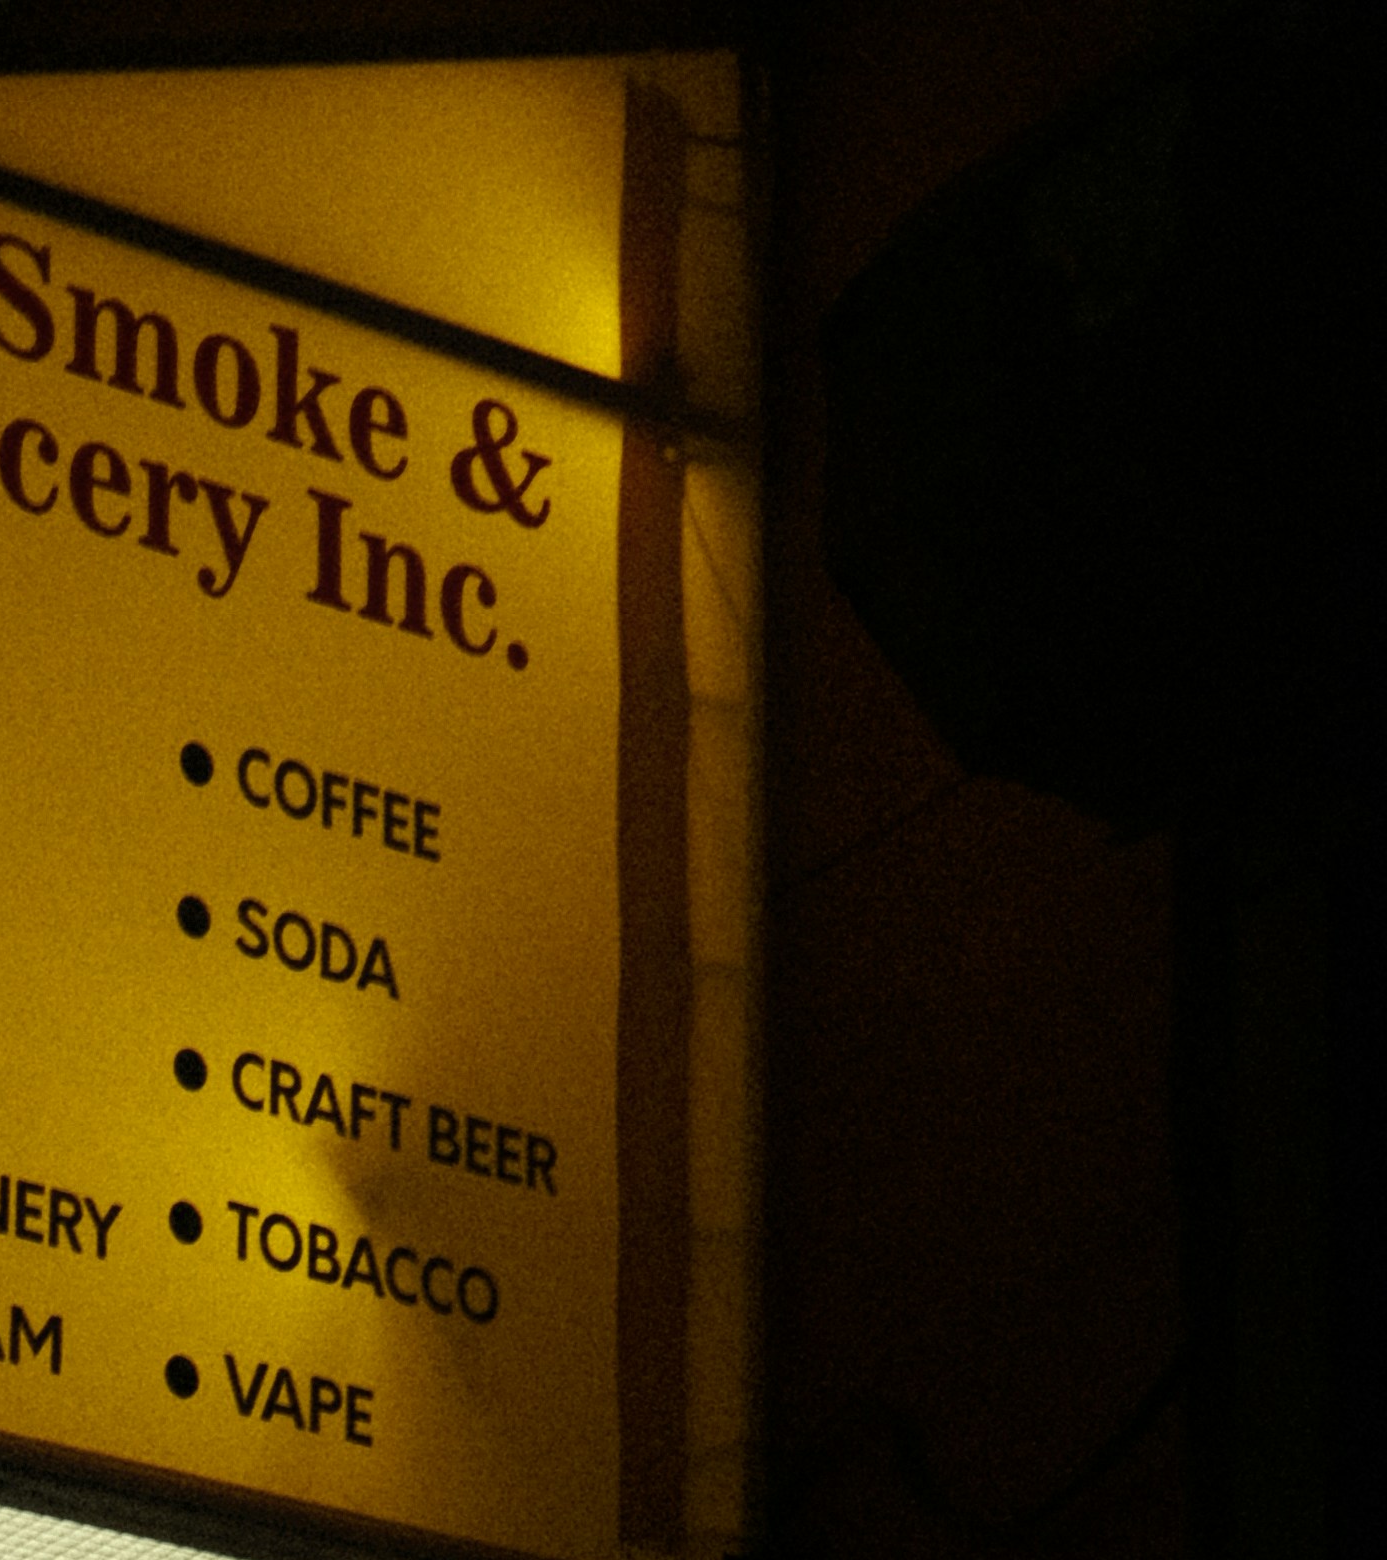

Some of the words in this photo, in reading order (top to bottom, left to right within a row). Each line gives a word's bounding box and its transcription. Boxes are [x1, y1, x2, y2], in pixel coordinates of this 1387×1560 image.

[449, 398, 552, 530] &
[305, 486, 530, 672] Inc.
[236, 747, 442, 862] COFFEE
[234, 898, 401, 1000] SODA
[230, 1052, 411, 1151] CRAFT
[427, 1101, 559, 1197] BEER
[227, 1201, 500, 1326] TOBACCO
[224, 1353, 375, 1448] VAPE
